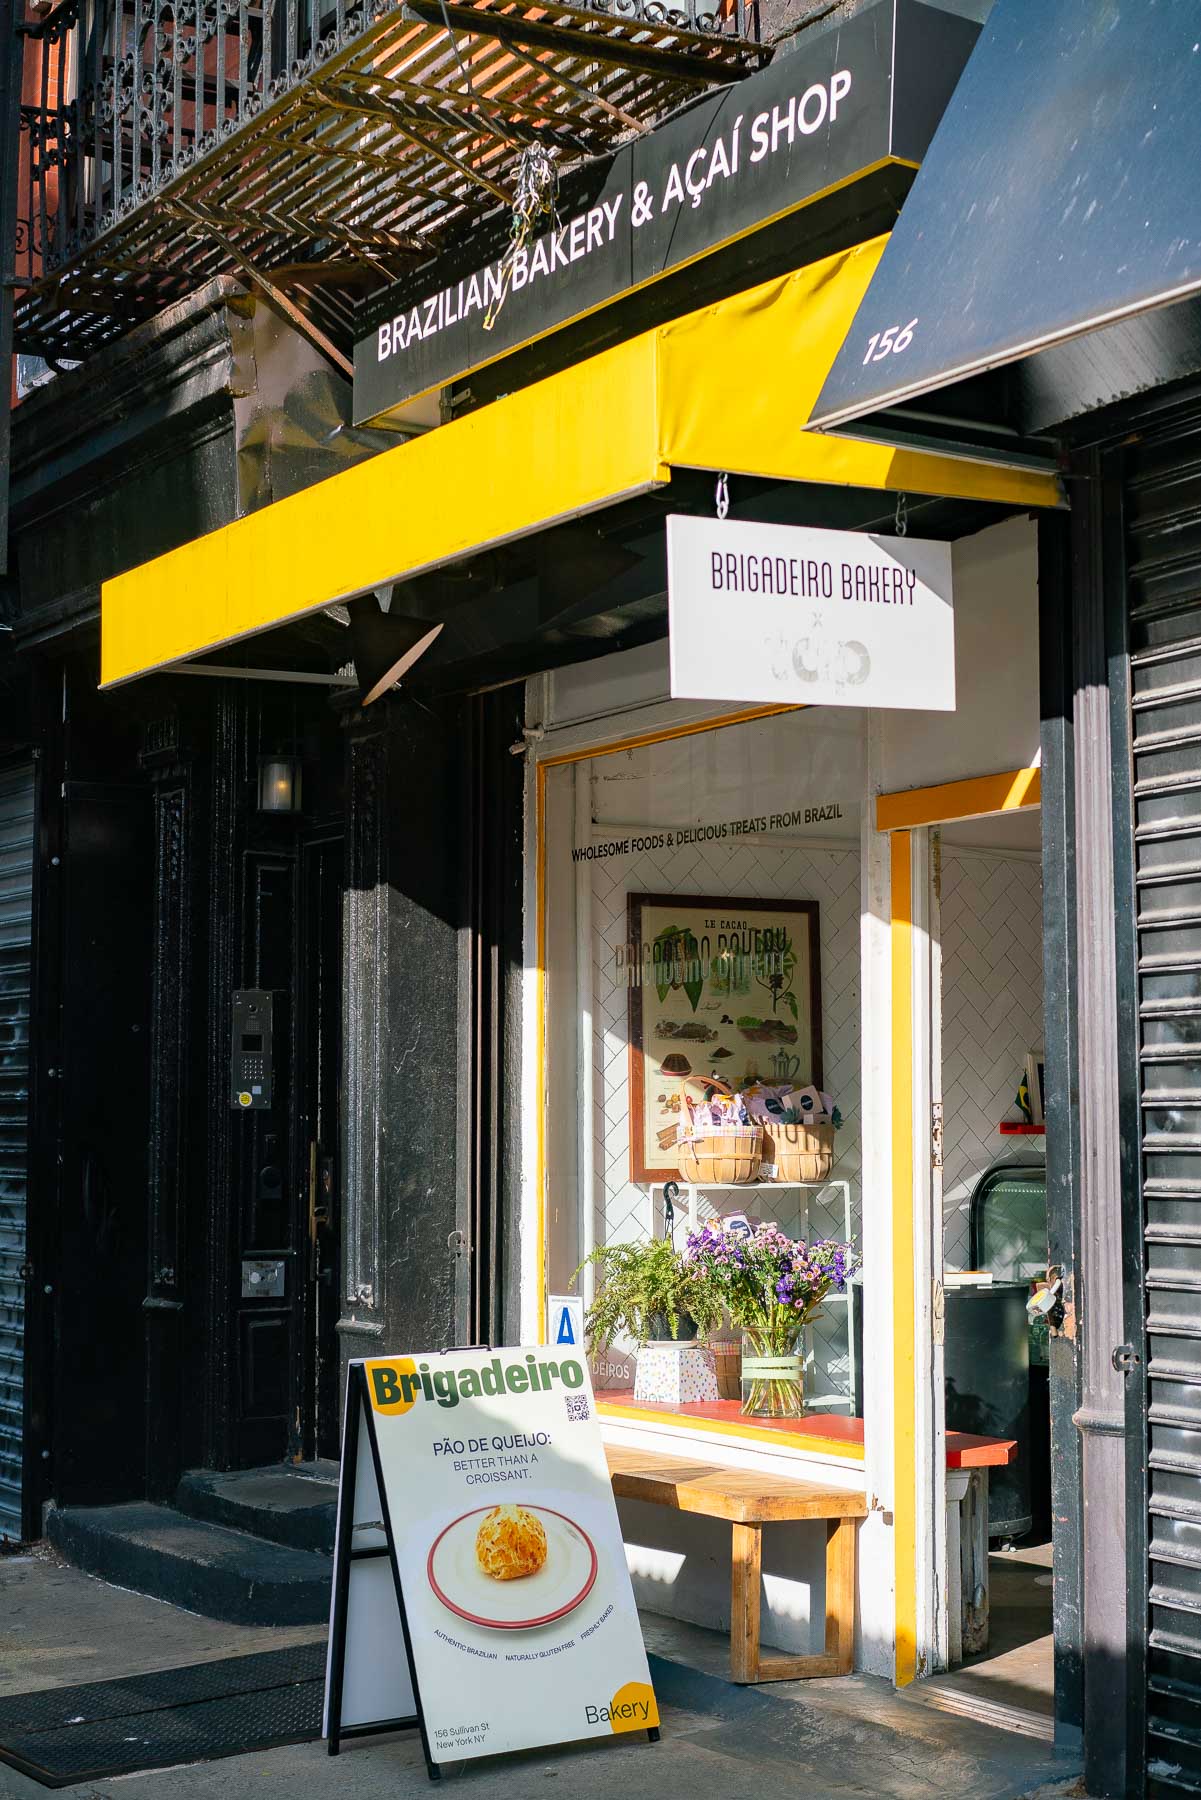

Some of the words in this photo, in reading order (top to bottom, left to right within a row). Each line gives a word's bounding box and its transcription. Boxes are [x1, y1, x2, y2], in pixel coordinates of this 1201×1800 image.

[378, 262, 504, 362] BRAZILIAN
[511, 192, 622, 291] BAKERY
[631, 181, 653, 228] &
[661, 114, 742, 212] AÇAÍ
[750, 69, 852, 163] SHOP
[861, 317, 919, 365] 156
[711, 551, 833, 599] BRIGADEIRO
[841, 563, 916, 606] BAKERY
[571, 840, 630, 863] WHOLESOME
[631, 834, 664, 853] FOODS
[666, 833, 674, 847] &
[676, 823, 728, 845] DELICIOUS
[729, 816, 767, 836] TREATS
[769, 810, 802, 830] FROM
[804, 803, 843, 824] BRAZIL
[704, 919, 716, 929] LE
[556, 1306, 575, 1345] A
[371, 1354, 584, 1408] Brigadeiro
[433, 1437, 465, 1457] PÃO
[468, 1438, 489, 1453] DE
[491, 1432, 552, 1451] QUEIJO:
[453, 1457, 496, 1472] BETTER
[499, 1455, 529, 1467] THAN
[531, 1454, 539, 1464] A
[466, 1469, 533, 1485] CROISSANT.
[580, 1620, 601, 1641] FRESHLY
[599, 1604, 614, 1623] BAKED
[434, 1628, 466, 1652] AUTHENTIC
[466, 1646, 498, 1660] BRAZILIAN
[505, 1652, 539, 1662] NATURALLY
[539, 1645, 562, 1659] GLUTEN
[560, 1639, 576, 1652] FREE
[585, 1699, 650, 1725] Bakery
[434, 1729, 449, 1739] 156
[449, 1724, 480, 1737] Sullivan
[481, 1722, 491, 1732] St
[436, 1740, 453, 1750] New
[454, 1736, 473, 1748] York
[474, 1734, 486, 1744] NY
